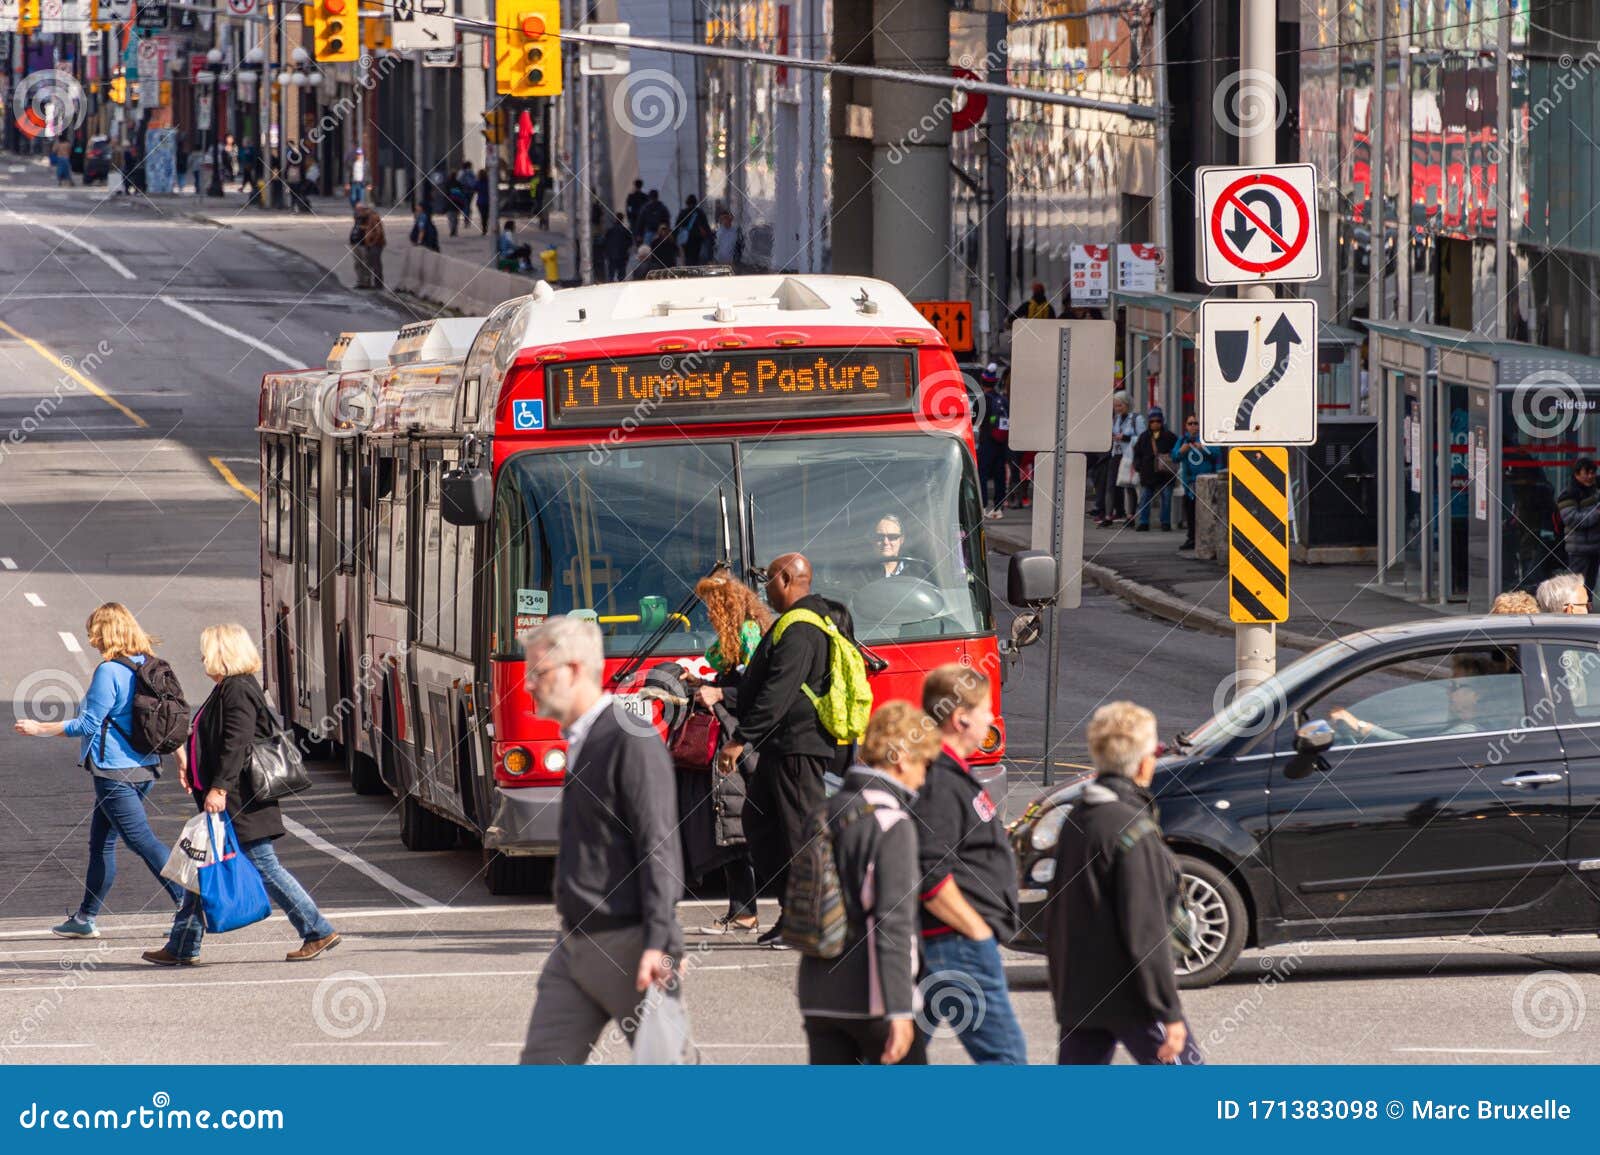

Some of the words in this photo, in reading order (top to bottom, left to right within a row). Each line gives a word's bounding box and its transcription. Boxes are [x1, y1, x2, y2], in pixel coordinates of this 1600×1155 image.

[563, 364, 600, 407] 14
[612, 362, 750, 400] Tunney's
[757, 357, 880, 393] Pasture
[1554, 398, 1597, 410] Rideau
[517, 616, 544, 627] FARE
